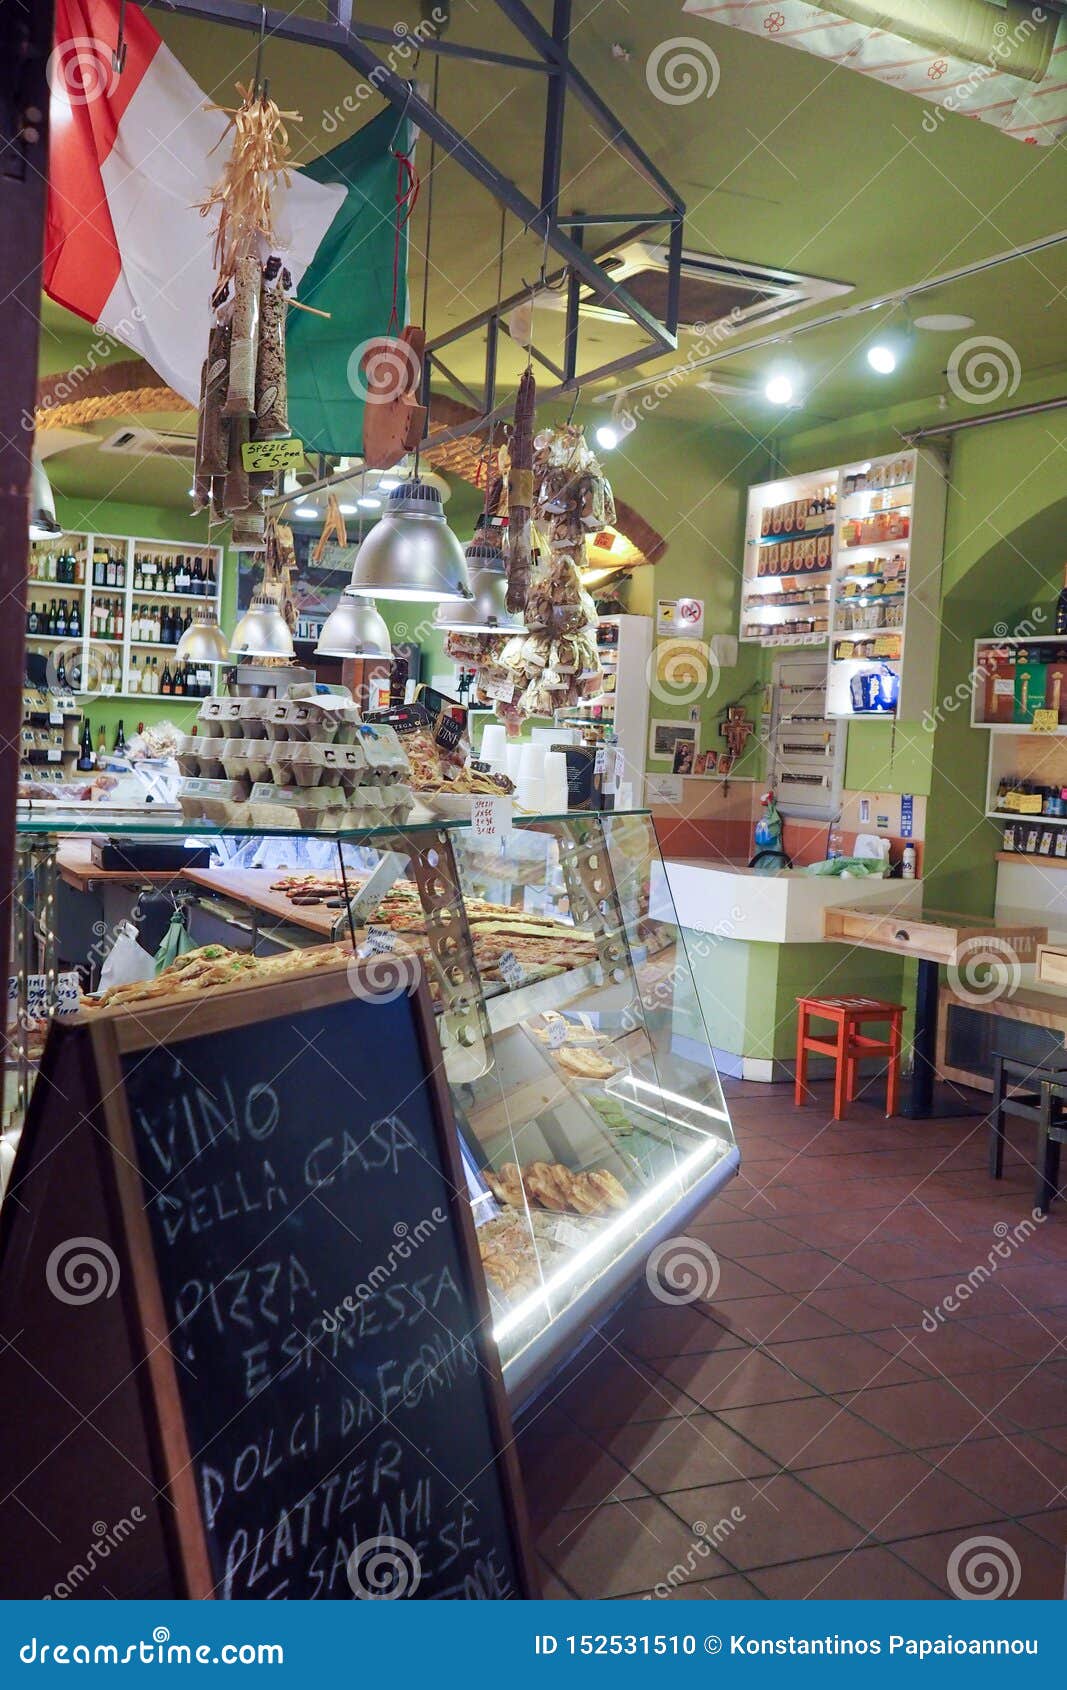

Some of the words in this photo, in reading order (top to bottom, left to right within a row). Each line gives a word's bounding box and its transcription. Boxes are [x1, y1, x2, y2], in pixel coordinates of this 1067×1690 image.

[137, 1062, 280, 1175] VINO
[158, 1160, 288, 1246] DELLA
[305, 1115, 425, 1188] CASA
[176, 1255, 316, 1350] PIZZA
[202, 1404, 321, 1530] DOLCI
[341, 1390, 373, 1437] DA
[223, 1440, 403, 1600] PLATTER
